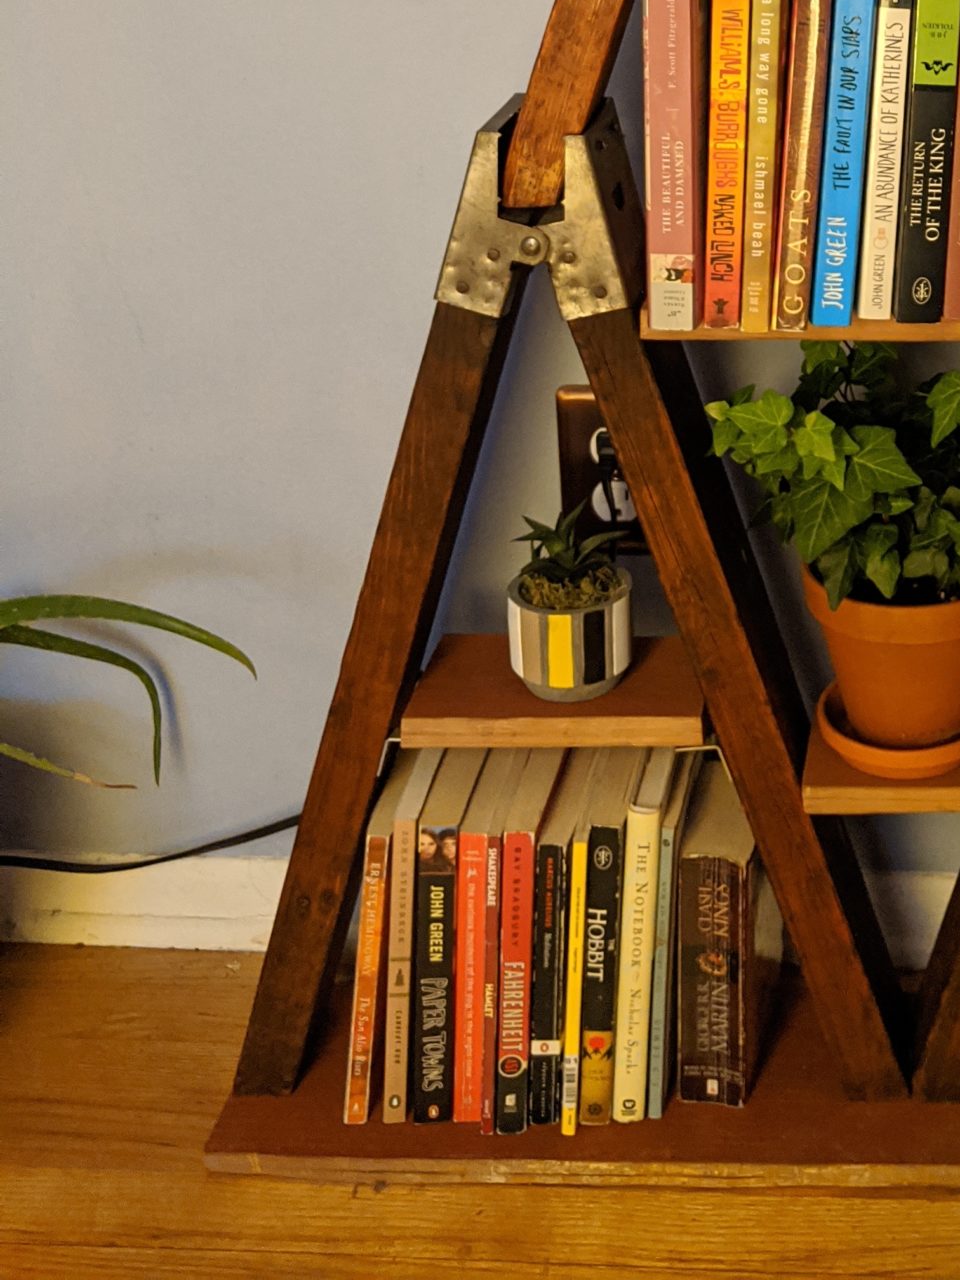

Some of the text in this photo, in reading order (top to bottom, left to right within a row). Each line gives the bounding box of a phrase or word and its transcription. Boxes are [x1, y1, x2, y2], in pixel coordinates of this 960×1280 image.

[667, 52, 677, 76] Scott
[756, 52, 770, 81] way
[757, 12, 774, 46] long
[755, 88, 769, 124] gone
[832, 15, 863, 191] THE FAULT IN OUR STARS
[874, 21, 904, 223] AN ABUNDANCE OF KATHERINES
[661, 132, 672, 234] THE BEAUTIFUL
[674, 140, 685, 226] AND DAMNED
[751, 156, 769, 257] ishmael beah
[909, 141, 926, 227] THE RETURN
[925, 128, 947, 242] OF THE KING
[710, 193, 736, 282] NAKED LUNCH
[821, 216, 848, 311] JOHN GREEN
[871, 254, 887, 309] JOHN GREEN
[398, 871, 408, 943] STEINBECK
[487, 847, 497, 907] SHAKESPEARE
[511, 847, 522, 946] RAY BRADBURY
[631, 842, 651, 967] THE NOTEBOOK
[697, 886, 714, 932] CLASH
[712, 883, 730, 938] KINGS
[429, 885, 445, 962] JOHN GREEN
[587, 908, 608, 983] HOBBIT
[353, 997, 371, 1076] The Sun Also Rises
[420, 977, 449, 1093] PAPER TOWNS
[484, 983, 495, 1018] HAMLET
[502, 961, 525, 1052] FAHRENHEIT
[709, 981, 730, 1056] MARTIN
